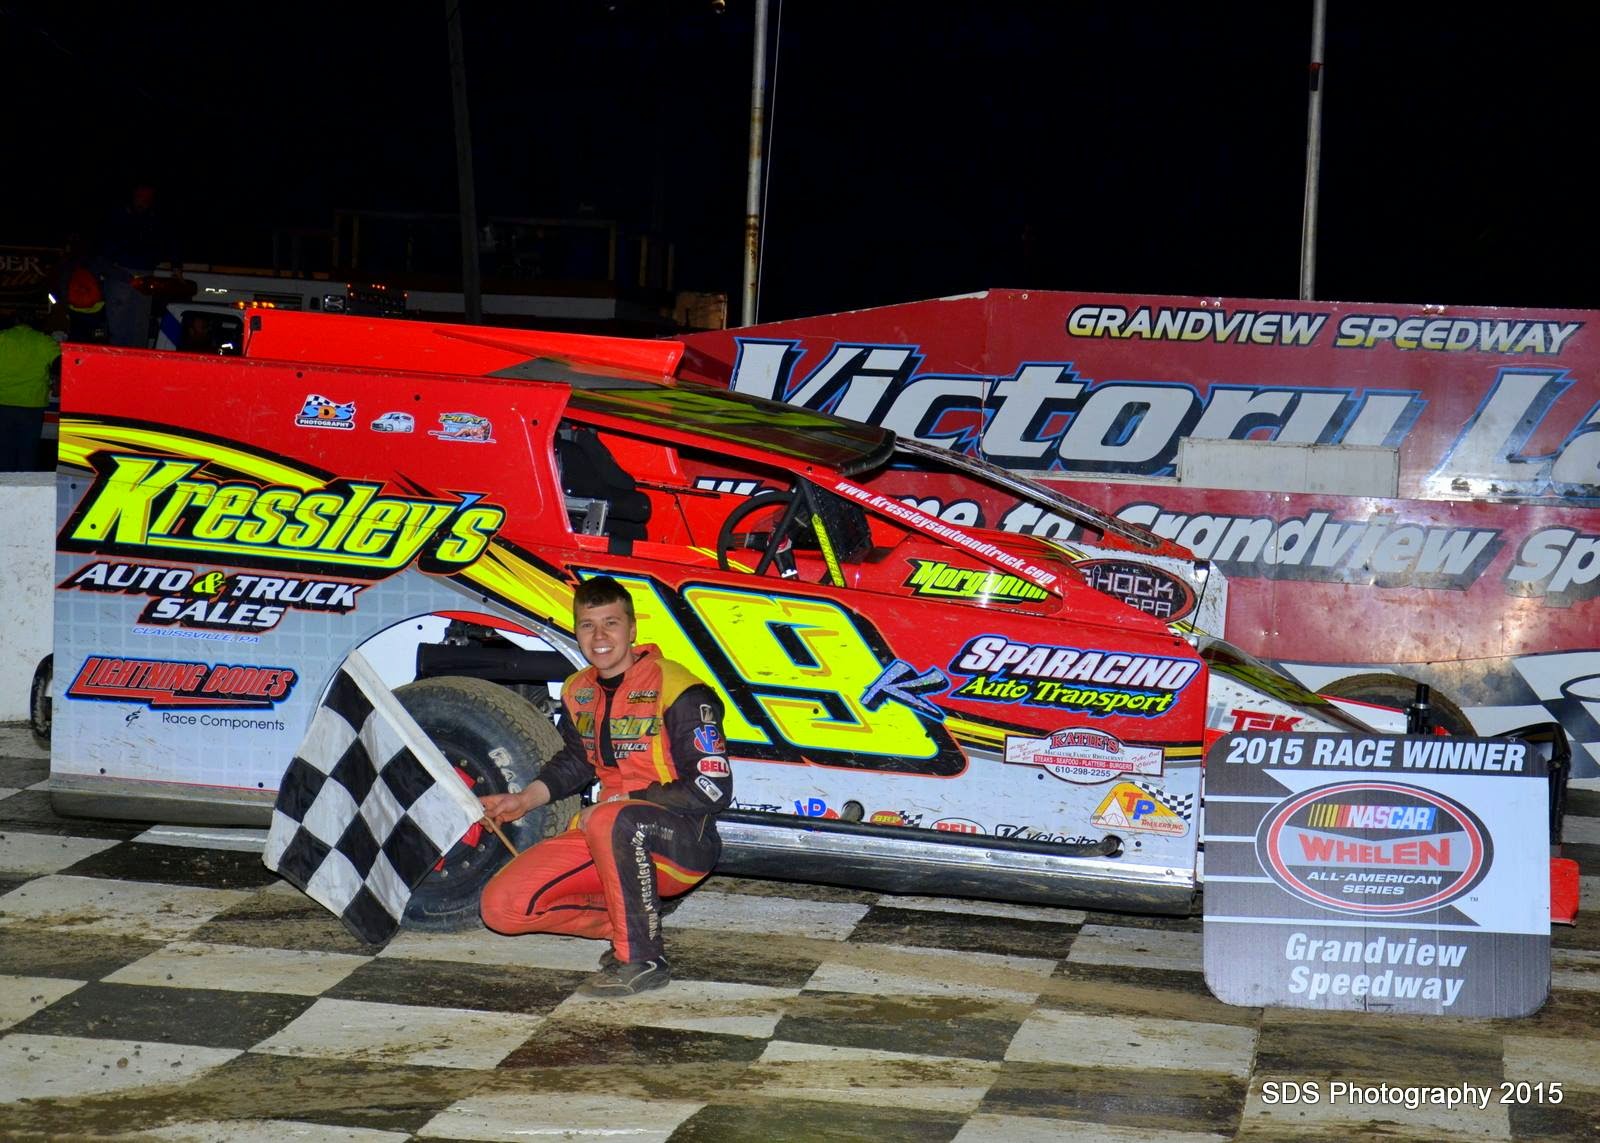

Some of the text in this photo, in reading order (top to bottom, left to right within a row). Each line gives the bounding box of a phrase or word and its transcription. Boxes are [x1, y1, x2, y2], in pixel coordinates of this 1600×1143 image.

[1067, 306, 1580, 355] GRANDVIEW SPEEDWAY
[300, 418, 351, 429] PHOTOGRAPHY
[302, 404, 354, 420] SDS
[72, 455, 503, 568] Kressley's
[834, 481, 1057, 586] www.Kressleysautoandtruck.com
[1112, 565, 1141, 574] THE
[76, 563, 362, 607] AUTO & TRUCK
[152, 597, 287, 627] SALES
[1124, 596, 1172, 618] SPA
[239, 635, 261, 644] PA
[959, 636, 1200, 690] SPARACINO
[71, 657, 294, 697] LIGHTNING BODIES
[861, 660, 948, 721] K
[960, 676, 1176, 715] Auto Transport
[162, 712, 197, 726] Race
[200, 715, 285, 731] Components
[614, 751, 629, 759] LES
[1051, 732, 1120, 754] KATIE'S
[1226, 737, 1527, 772] 2015 RACE WINNER
[700, 760, 728, 774] BELL
[1034, 756, 1053, 764] STEAKS
[1056, 758, 1079, 766] SEAFOOD
[1082, 760, 1106, 768] PLATTERS
[1109, 762, 1133, 771] BURGERS
[1055, 766, 1111, 778] 610-298-2255
[1124, 792, 1155, 820] TP
[1349, 805, 1432, 829] NASCAR
[1299, 833, 1451, 866] WHELEN
[1307, 871, 1442, 885] ALL-AMERICAN
[1342, 885, 1405, 895] SERIES
[1285, 933, 1467, 967] Grandview
[1288, 966, 1464, 1006] Speedway
